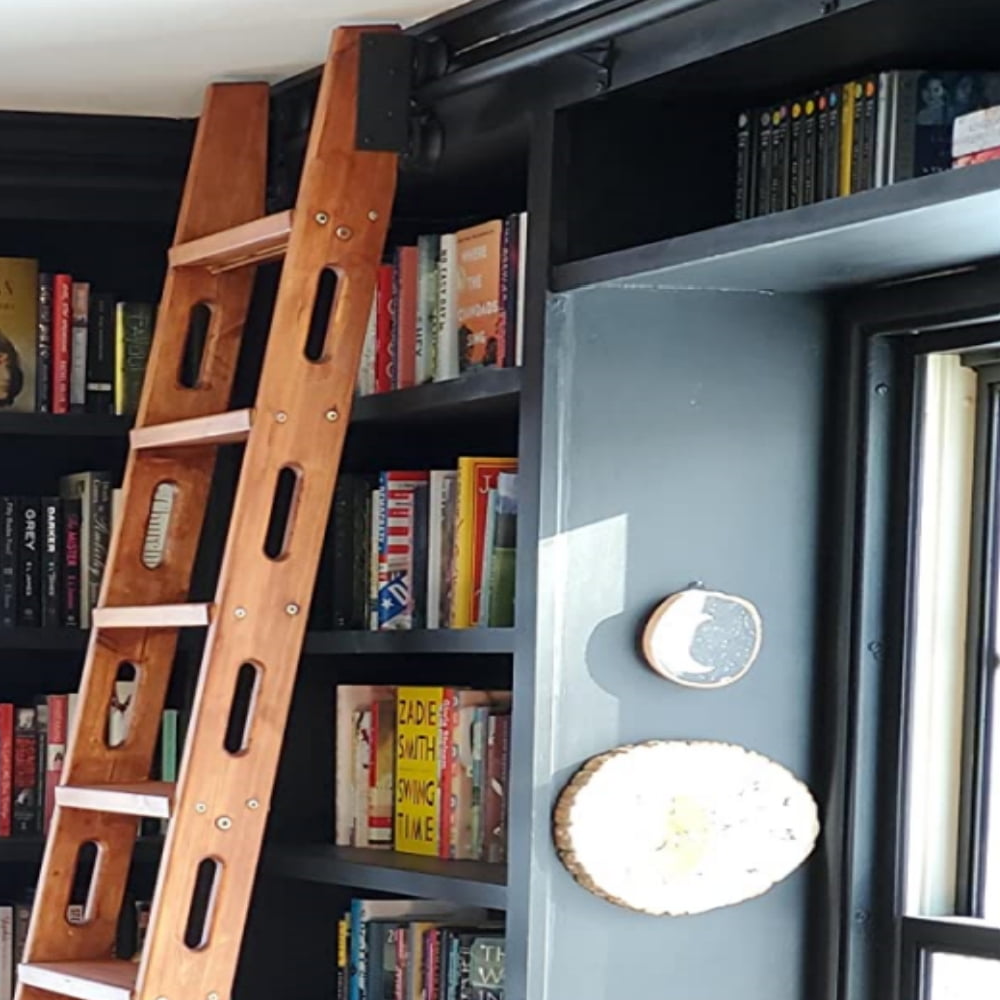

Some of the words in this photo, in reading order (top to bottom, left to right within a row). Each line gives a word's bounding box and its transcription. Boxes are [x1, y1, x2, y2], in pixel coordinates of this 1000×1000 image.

[24, 508, 37, 551] GREY
[47, 506, 56, 553] DARKER
[398, 700, 437, 726] ZADIE
[398, 735, 436, 762] SMITH
[397, 779, 435, 807] SWING
[397, 813, 434, 842] TIME
